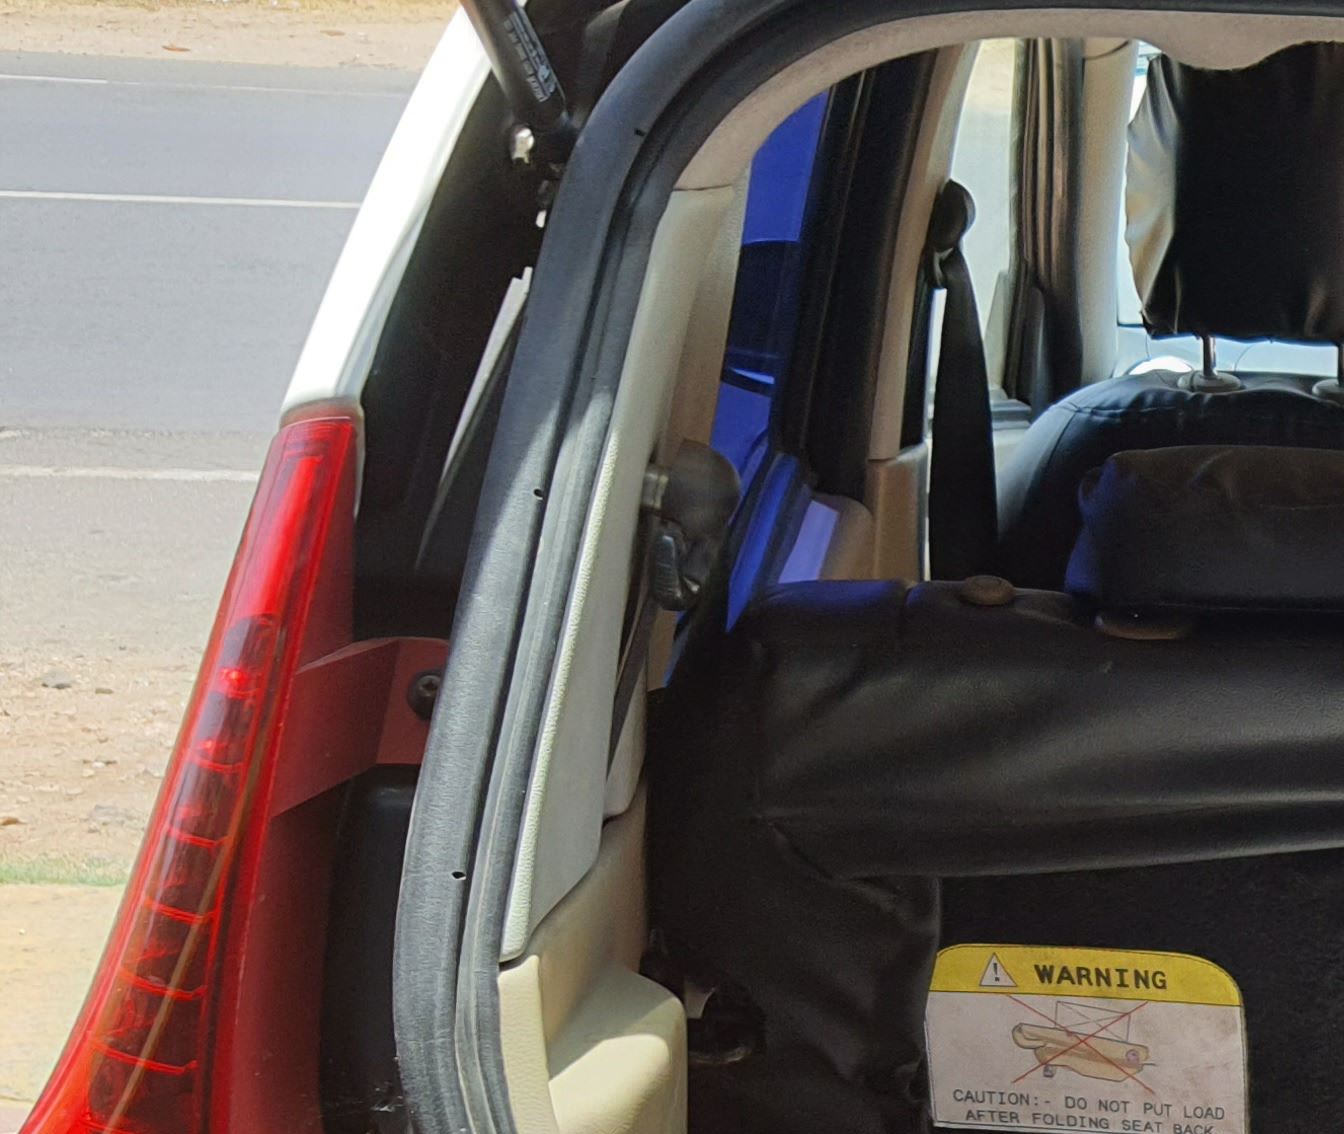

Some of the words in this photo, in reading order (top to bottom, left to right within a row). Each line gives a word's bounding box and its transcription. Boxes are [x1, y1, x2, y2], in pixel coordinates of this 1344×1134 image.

[1034, 963, 1168, 991] WARNING
[965, 1109, 1020, 1124] AFTER
[1031, 1112, 1110, 1131] FOLDING
[1121, 1118, 1163, 1133] SEAT
[1064, 1095, 1088, 1111] DO
[1098, 1098, 1131, 1114] NOT
[1143, 1101, 1173, 1118] PUT
[1183, 1105, 1225, 1121] LOAD
